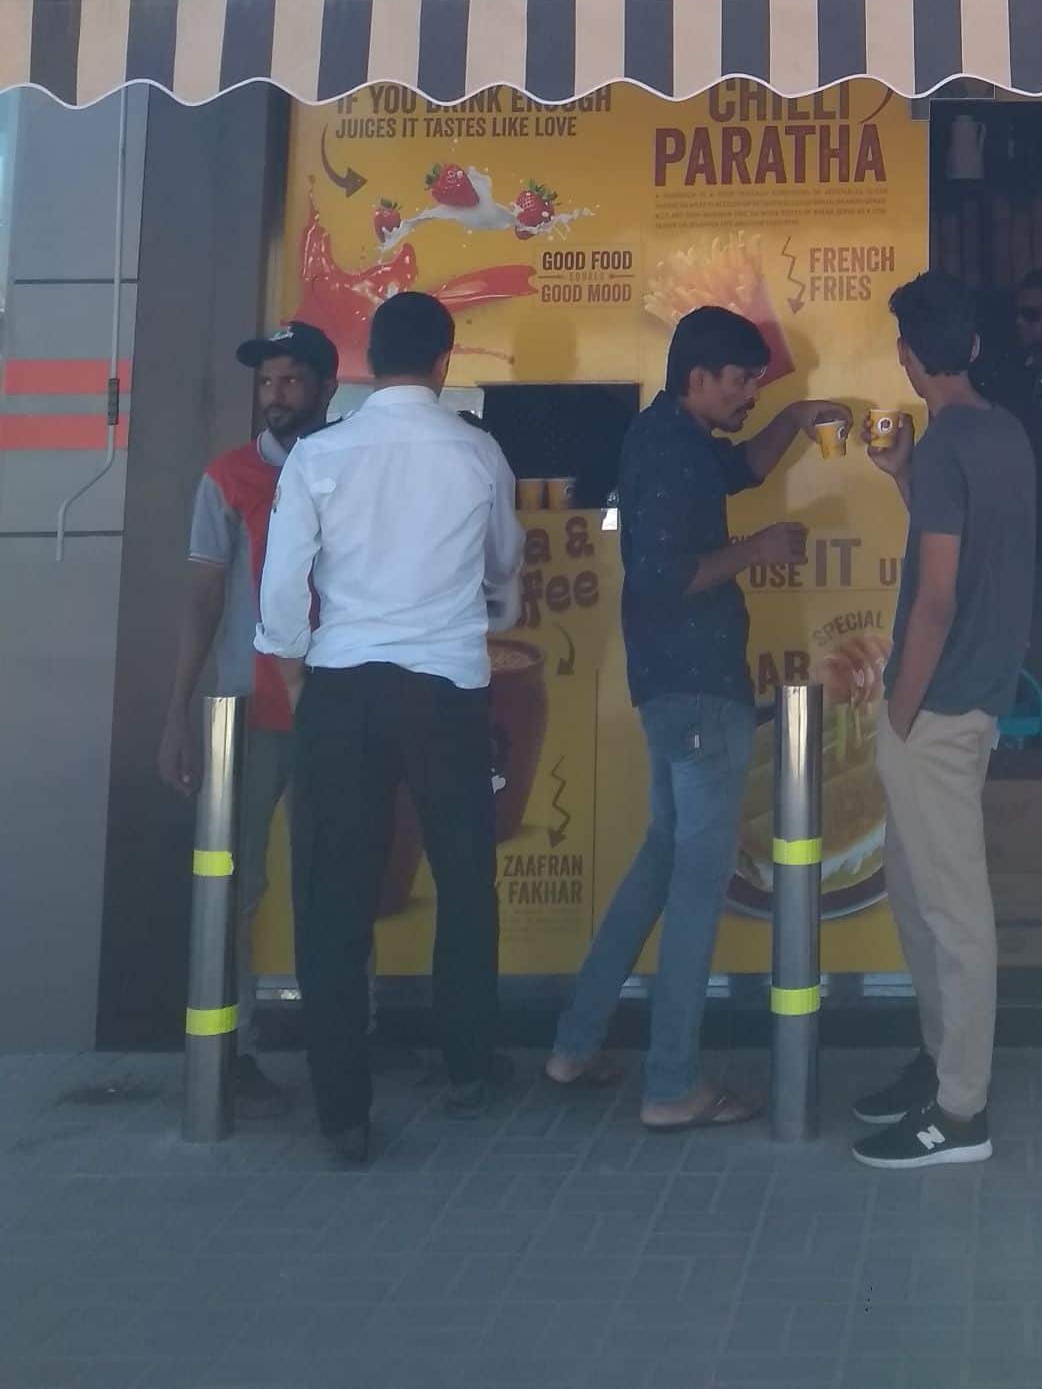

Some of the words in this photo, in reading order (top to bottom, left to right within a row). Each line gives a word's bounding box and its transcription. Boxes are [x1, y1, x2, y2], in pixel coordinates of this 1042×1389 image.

[369, 85, 417, 114] YOU
[336, 117, 397, 139] JUICES
[402, 117, 419, 138] IT
[424, 117, 487, 138] TASTES
[492, 116, 529, 137] LIKE
[535, 116, 577, 136] LOVE
[654, 124, 887, 187] PARATHA
[542, 251, 586, 270] GOOD
[591, 251, 633, 270] FOOD
[809, 246, 895, 273] FRENCH
[541, 284, 583, 303] GOOD
[588, 284, 632, 302] MOOD
[809, 275, 872, 302] FRIES
[815, 538, 862, 587] IT
[811, 609, 885, 648] SPECIAL
[504, 854, 583, 877] ZAAFRAN
[508, 880, 584, 905] FAKHAR
